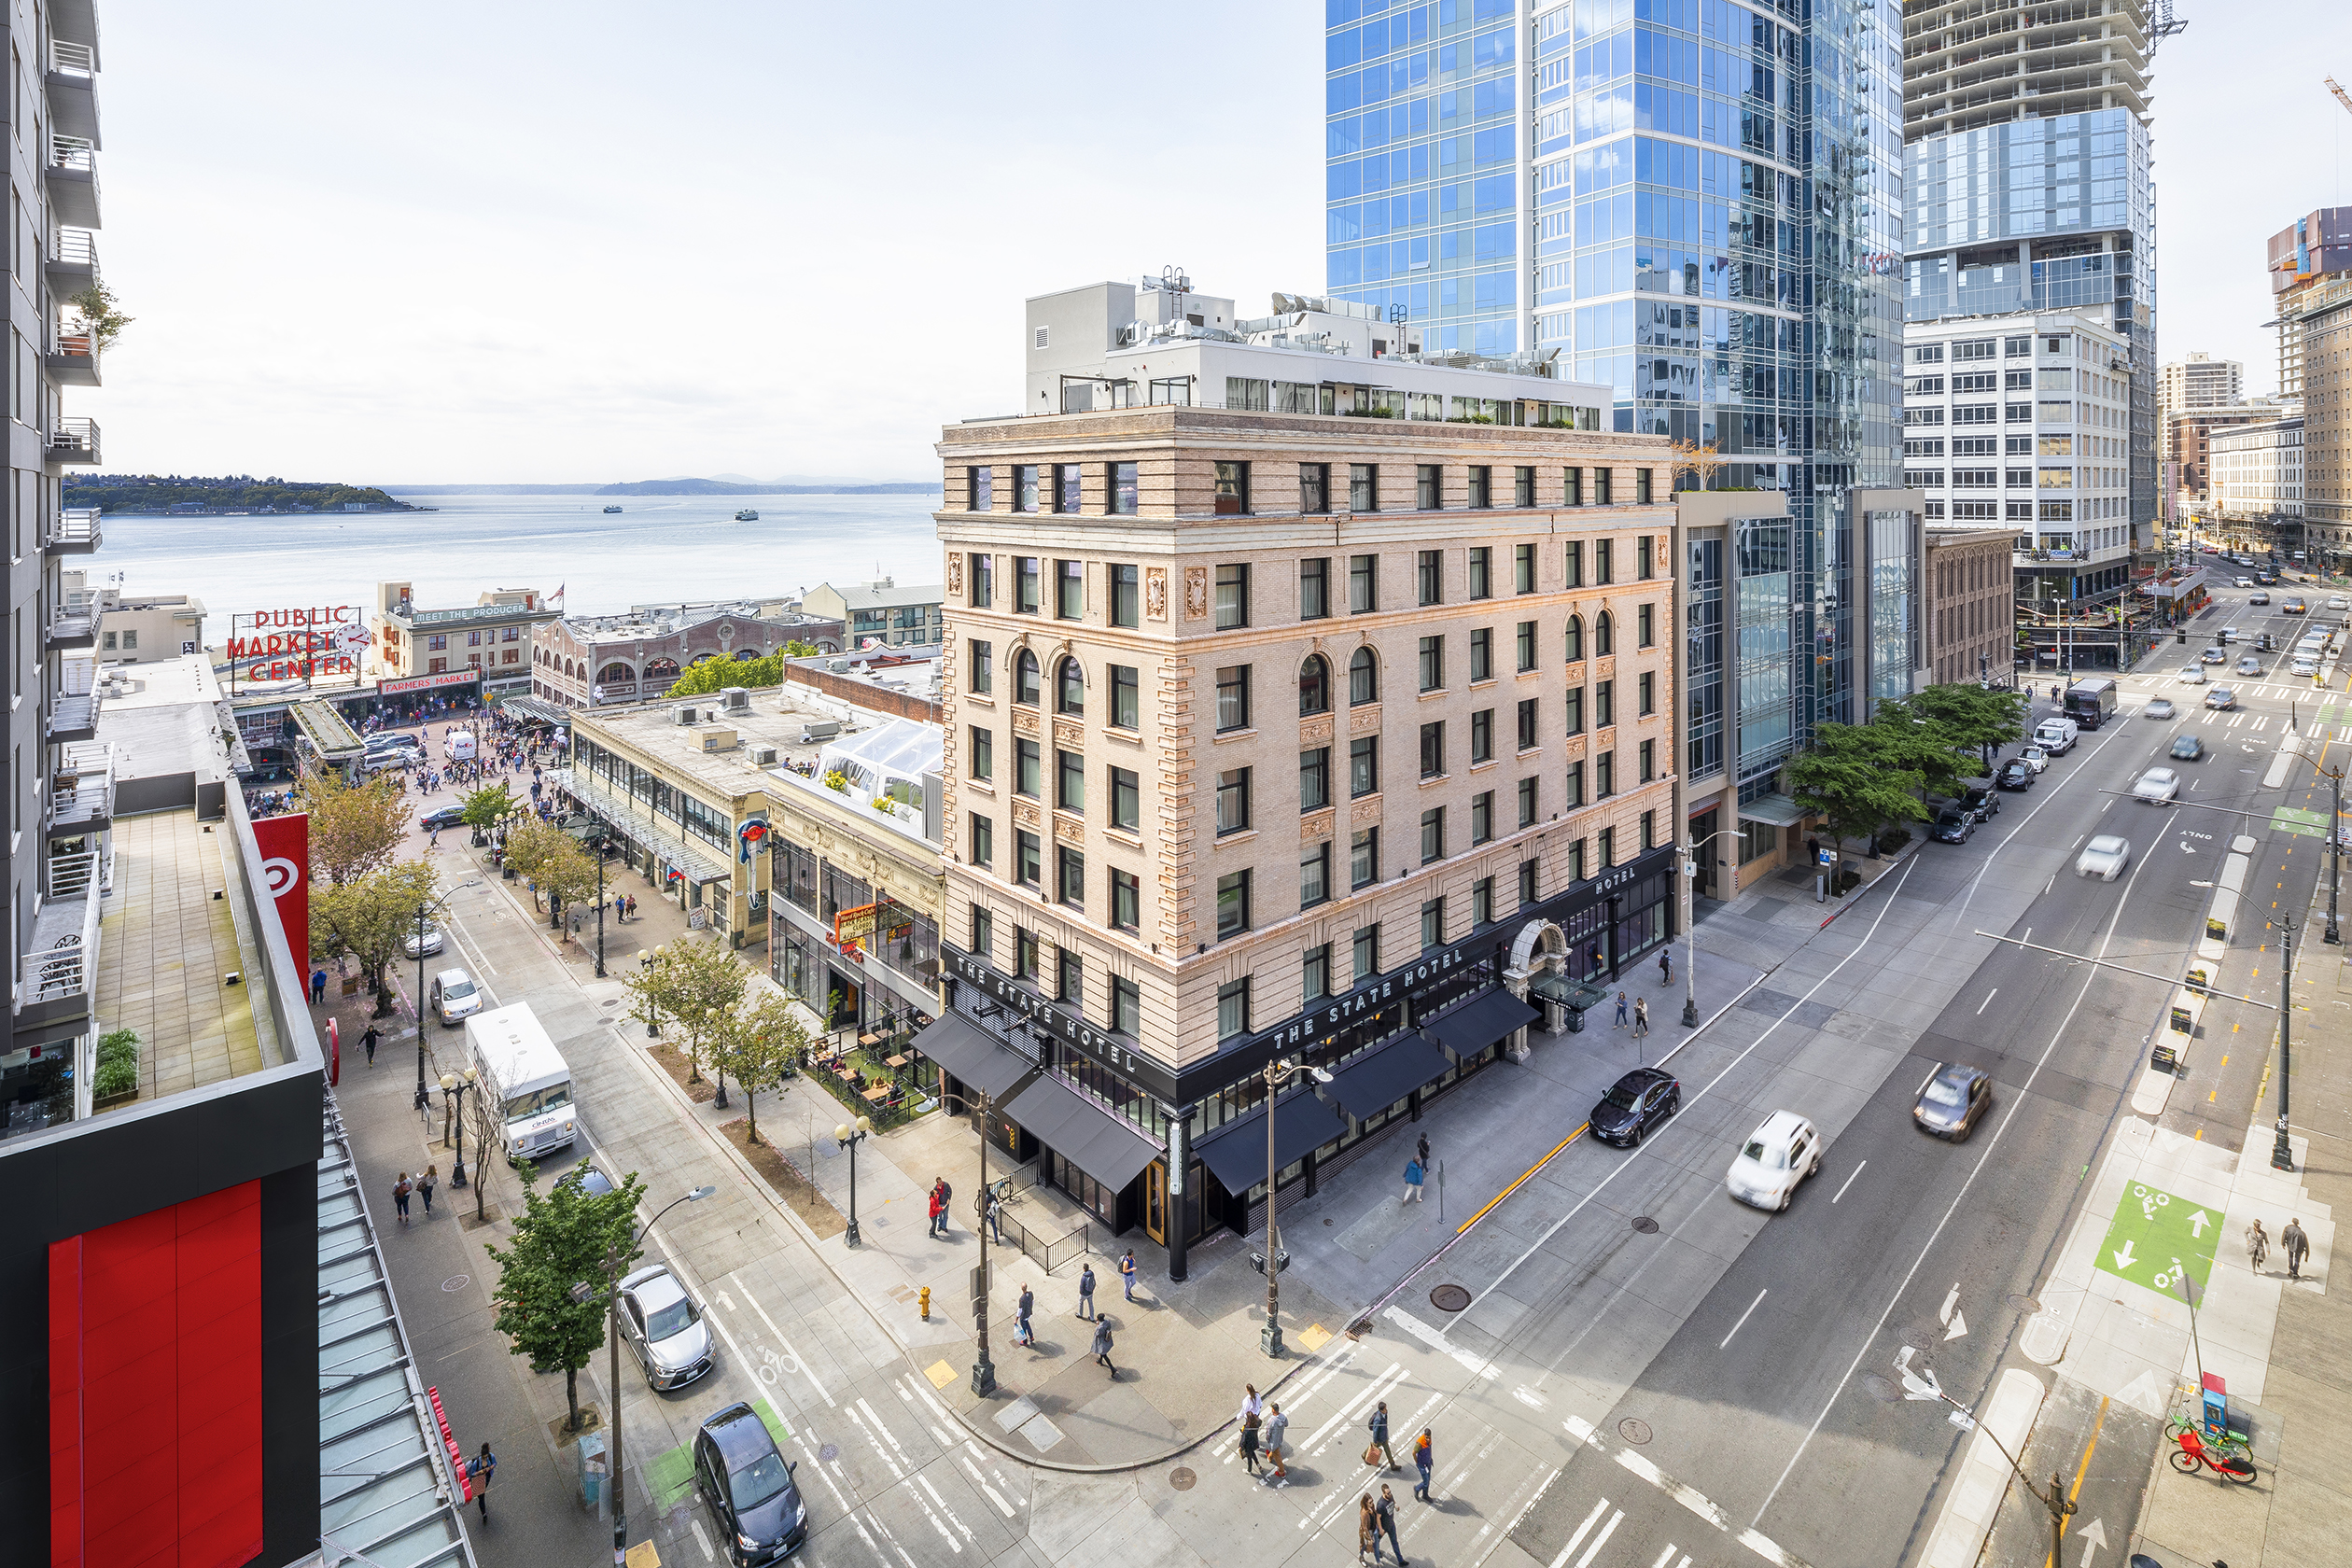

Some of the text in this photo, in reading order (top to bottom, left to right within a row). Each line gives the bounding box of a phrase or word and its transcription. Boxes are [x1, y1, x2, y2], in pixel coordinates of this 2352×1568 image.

[256, 606, 348, 629] PUBLIC
[416, 605, 525, 622] MEET THE PRODUCER
[227, 631, 334, 659] MARKET
[250, 657, 352, 681] CENTER
[385, 672, 475, 693] FARMERS MARKET
[2179, 830, 2213, 840] ONLY
[1595, 867, 1635, 895] HOTEL
[852, 910, 864, 918] Rock
[852, 921, 873, 931] CLOUDS
[1274, 949, 1463, 1049] THE STATE HOTEL
[957, 957, 1136, 1073] THE STATE HOTEL
